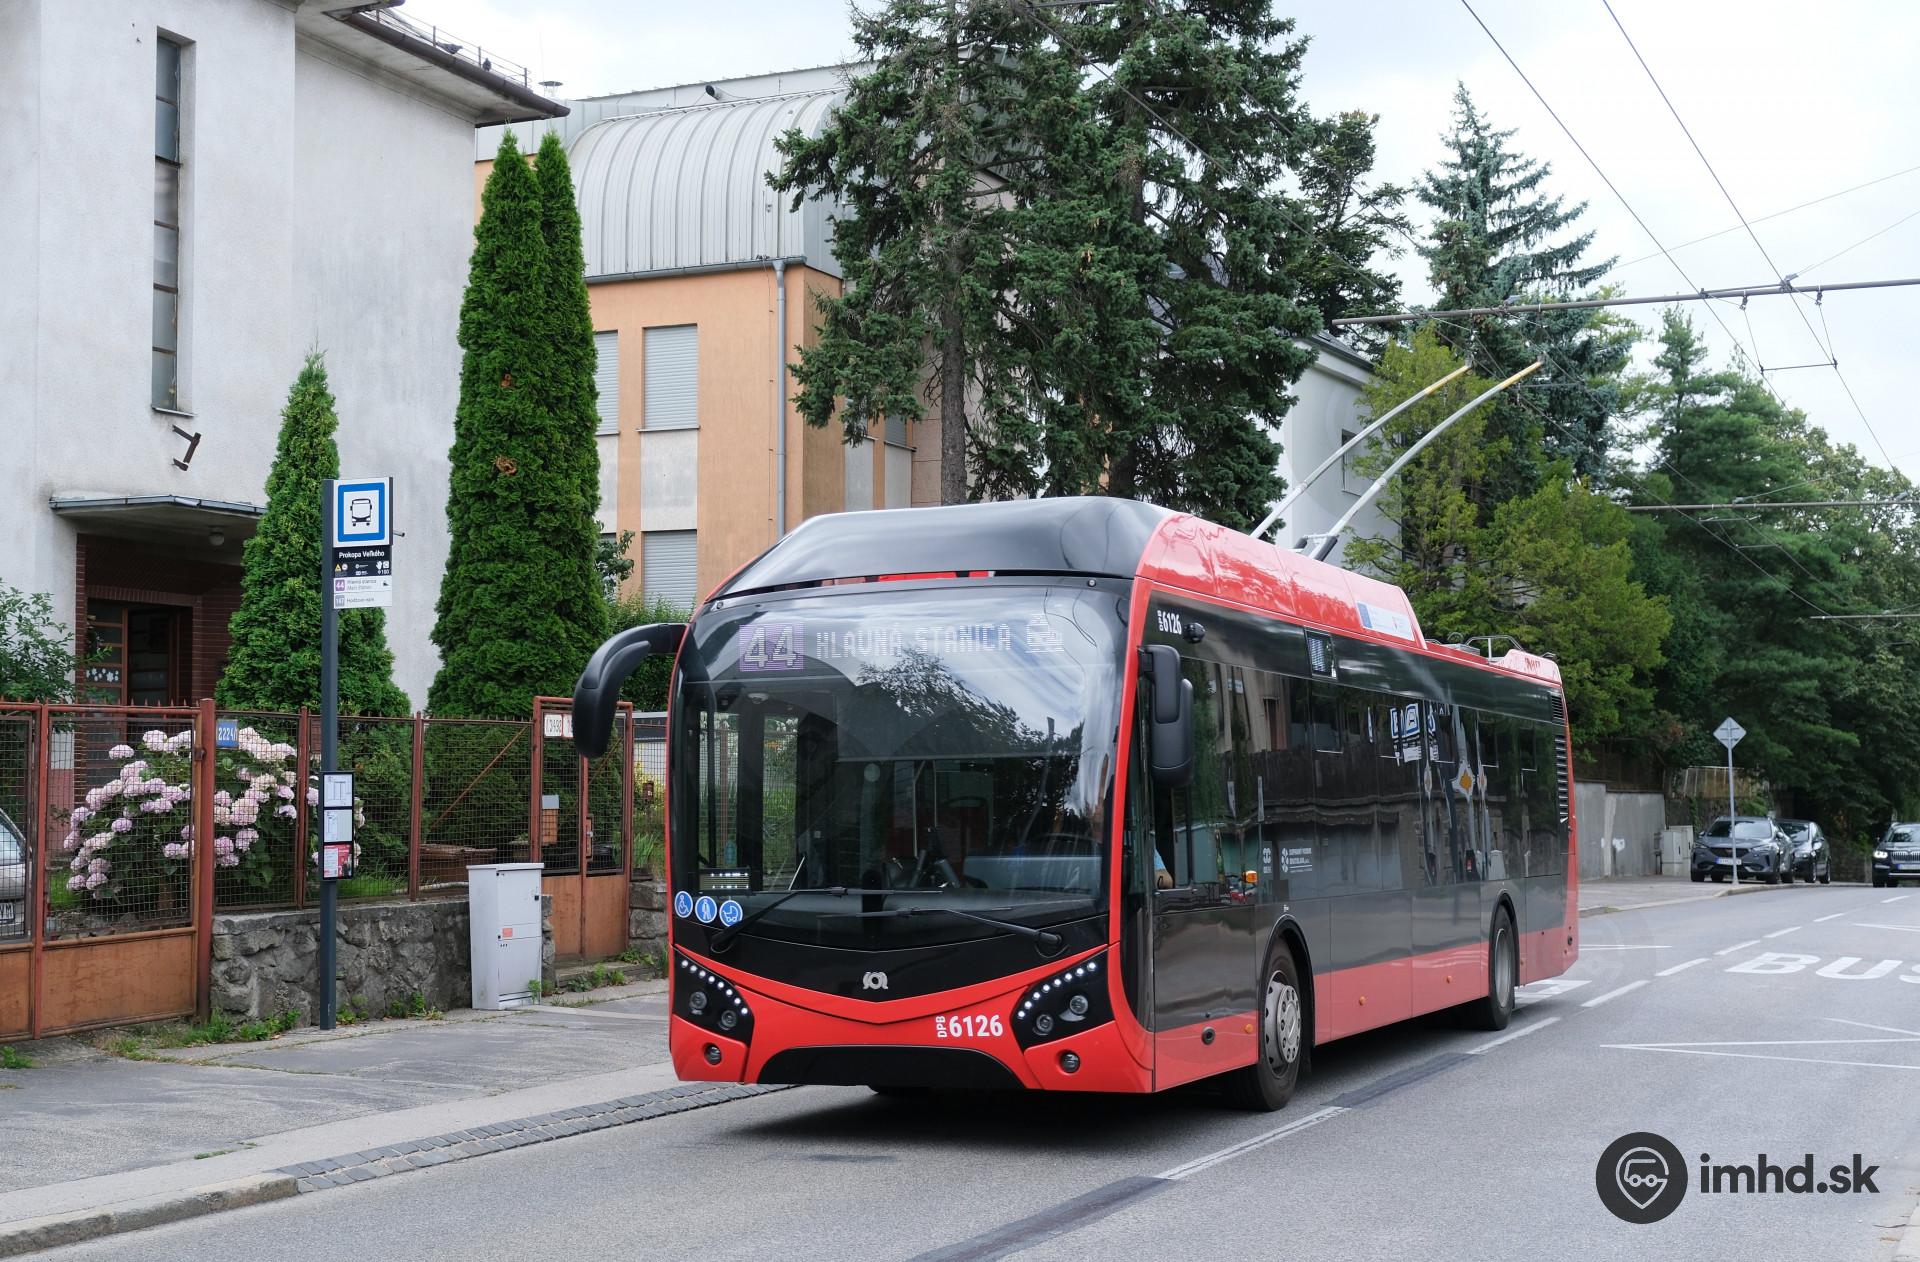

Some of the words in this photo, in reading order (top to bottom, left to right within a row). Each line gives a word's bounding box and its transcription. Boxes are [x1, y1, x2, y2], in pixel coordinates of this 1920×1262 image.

[338, 551, 361, 559] Prokopa
[335, 581, 345, 589] 44
[1162, 611, 1182, 635] 6126
[743, 625, 798, 668] 44
[816, 622, 903, 659] HLAVNÁ
[914, 623, 1012, 654] STANICA
[935, 1015, 948, 1038] DPB
[949, 1014, 1004, 1038] 6126
